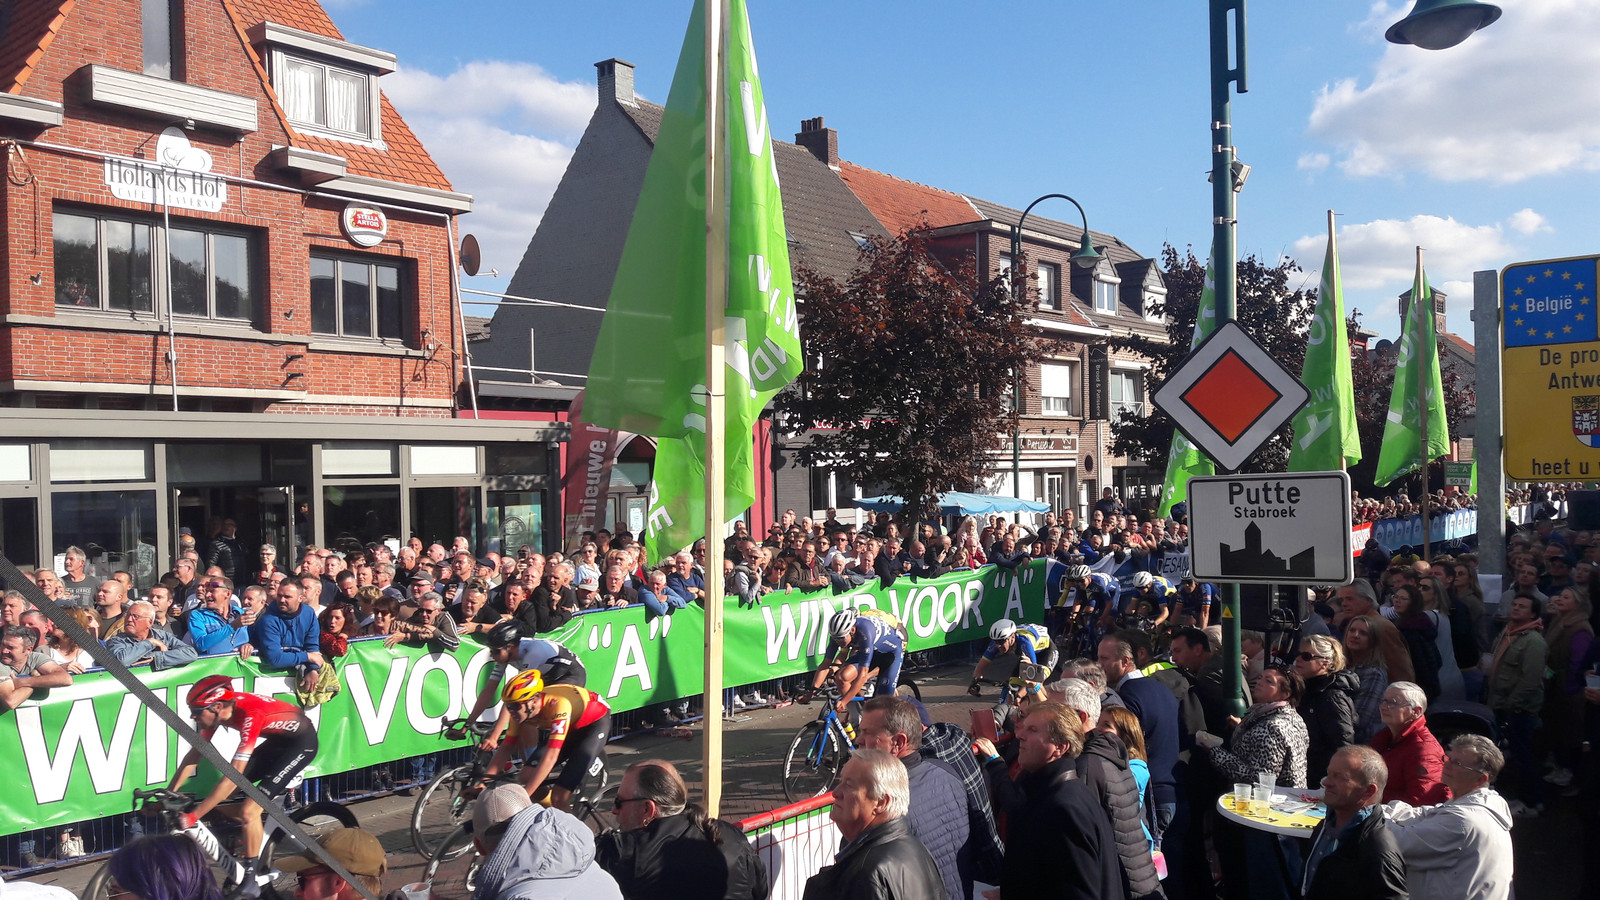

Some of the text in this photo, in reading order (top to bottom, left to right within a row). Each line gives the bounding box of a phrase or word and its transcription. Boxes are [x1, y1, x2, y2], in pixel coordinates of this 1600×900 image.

[356, 213, 379, 221] STELLA
[356, 219, 380, 228] ARTOIS
[1525, 295, 1573, 315] België
[1540, 349, 1562, 366] De
[1532, 458, 1590, 476] heet u
[580, 439, 607, 517] nieuwe
[1228, 481, 1301, 505] Putte
[1234, 506, 1297, 519] Stabroek
[888, 579, 985, 638] VOOR
[344, 645, 520, 747] VOO
[262, 720, 301, 733] ARKEA
[272, 753, 306, 784] SAMSIC
